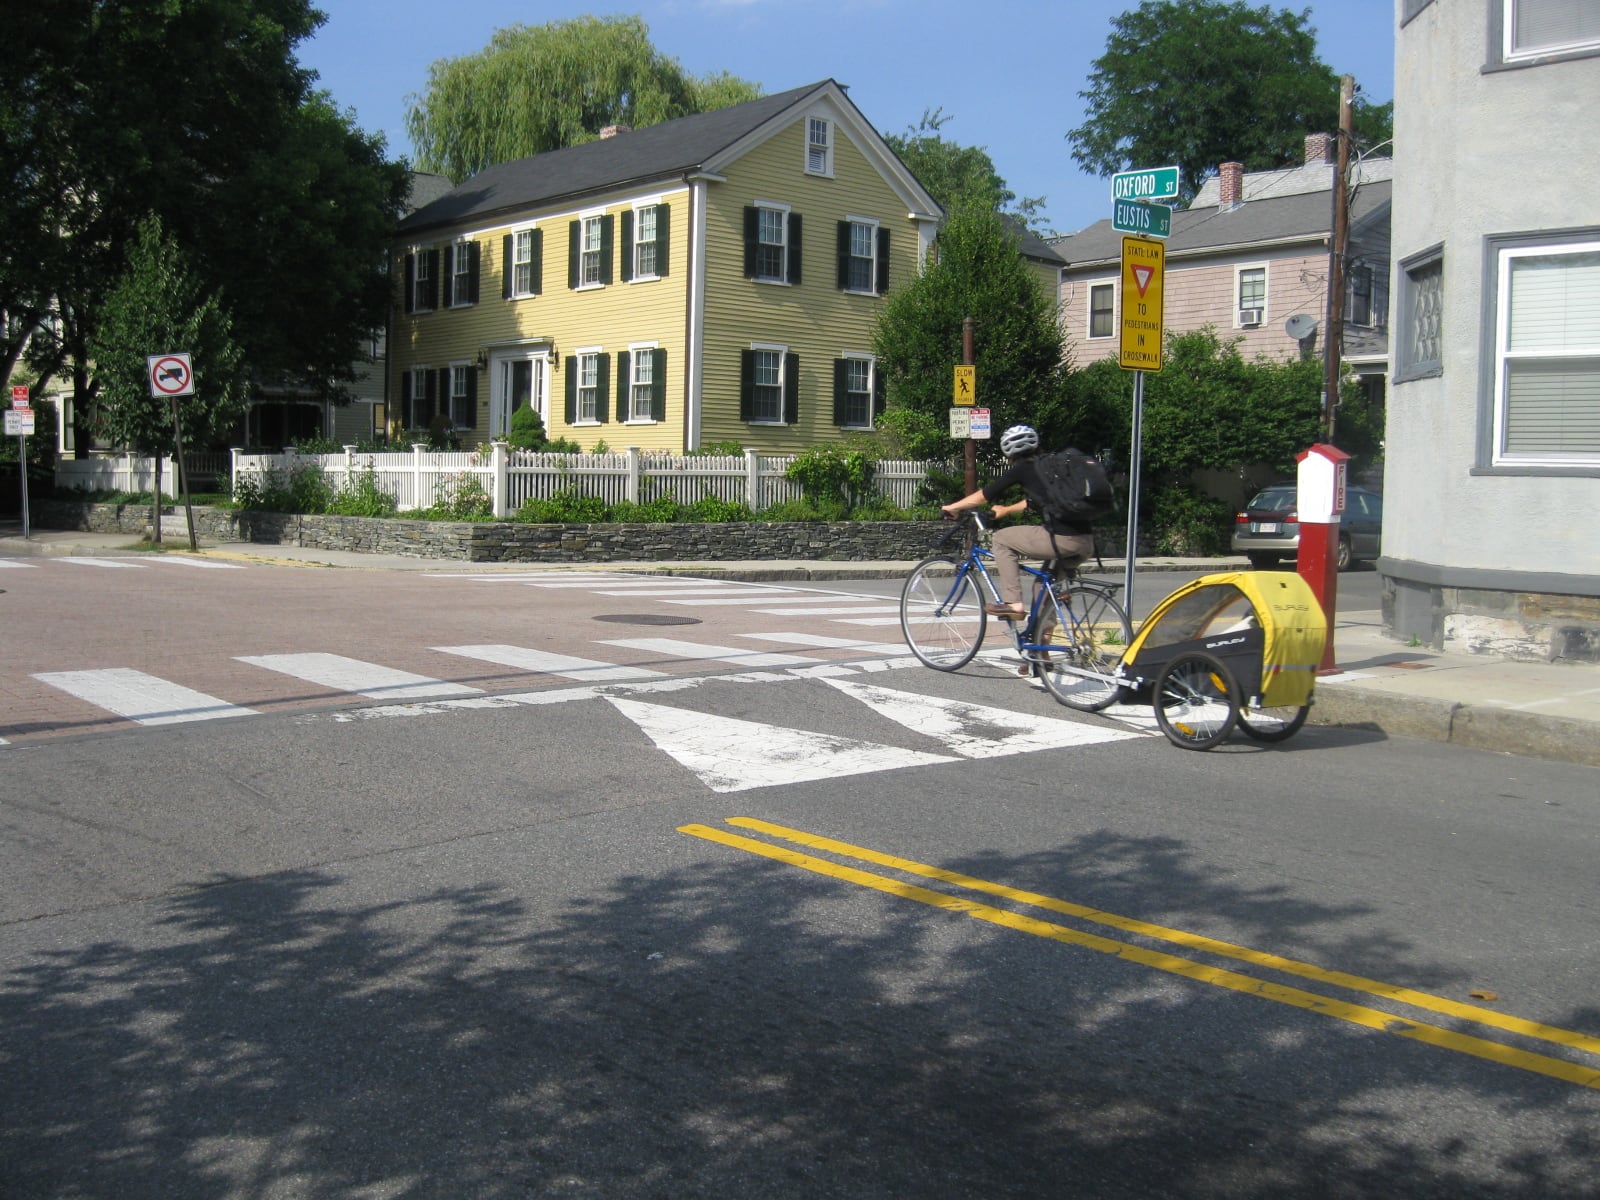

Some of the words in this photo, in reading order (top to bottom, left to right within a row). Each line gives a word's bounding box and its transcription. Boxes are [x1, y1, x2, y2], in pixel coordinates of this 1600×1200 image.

[1115, 174, 1156, 198] OXFORD
[1165, 181, 1174, 192] ST
[1117, 204, 1150, 229] EUSTIS
[1160, 218, 1169, 232] ST
[1127, 245, 1145, 258] STATE
[1146, 248, 1159, 260] LAW
[1137, 303, 1147, 316] TO
[1124, 319, 1159, 331] PEDESTRIANS
[1137, 334, 1145, 347] IN
[1123, 350, 1158, 363] CROSSWALK
[956, 369, 973, 377] SLOW
[1337, 464, 1345, 509] FIRE
